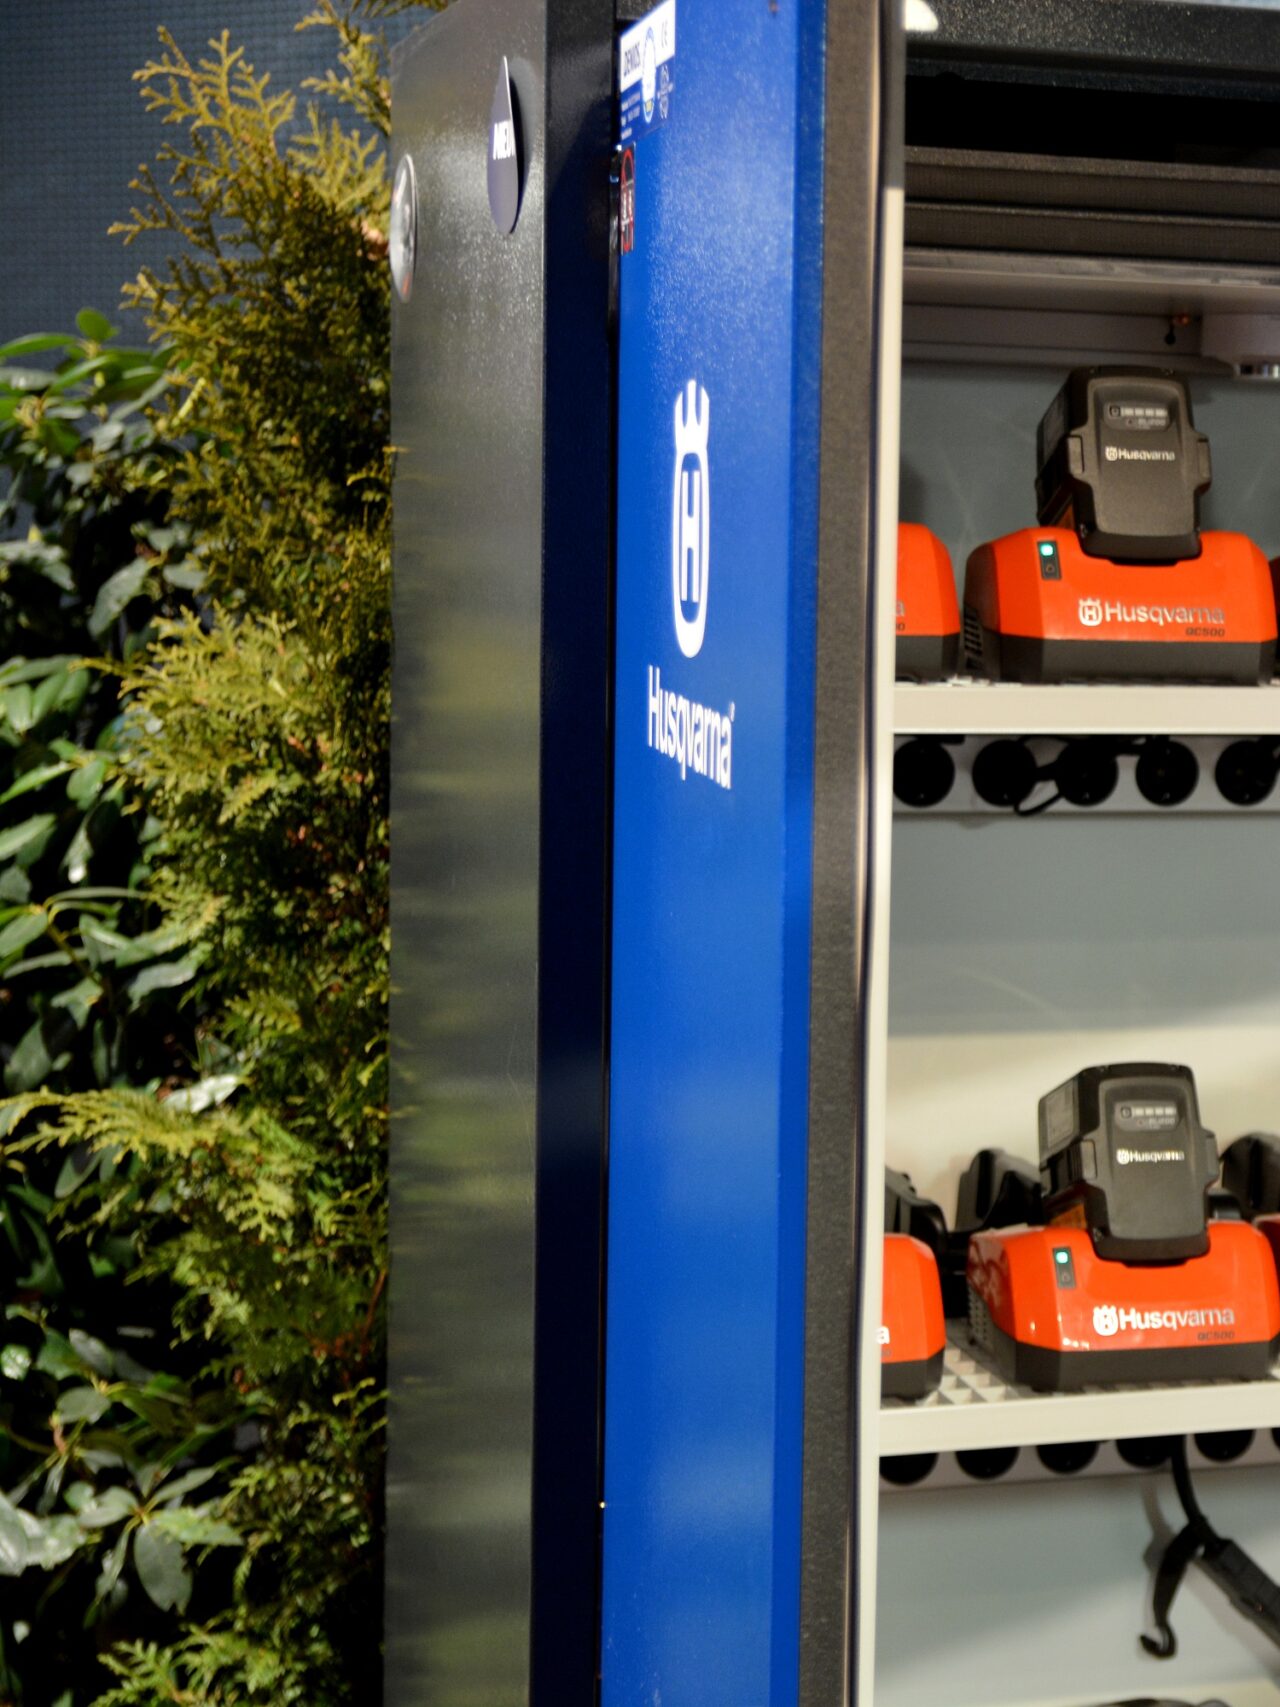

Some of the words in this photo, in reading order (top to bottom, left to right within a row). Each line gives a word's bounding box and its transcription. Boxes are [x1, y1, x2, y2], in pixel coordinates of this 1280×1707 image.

[1118, 448, 1175, 461] Husqvarna
[1105, 601, 1225, 627] Husqvarna
[648, 664, 732, 790] Husqvarna
[1129, 1149, 1185, 1163] Husqvarna
[1118, 1307, 1235, 1331] Husqvarna
